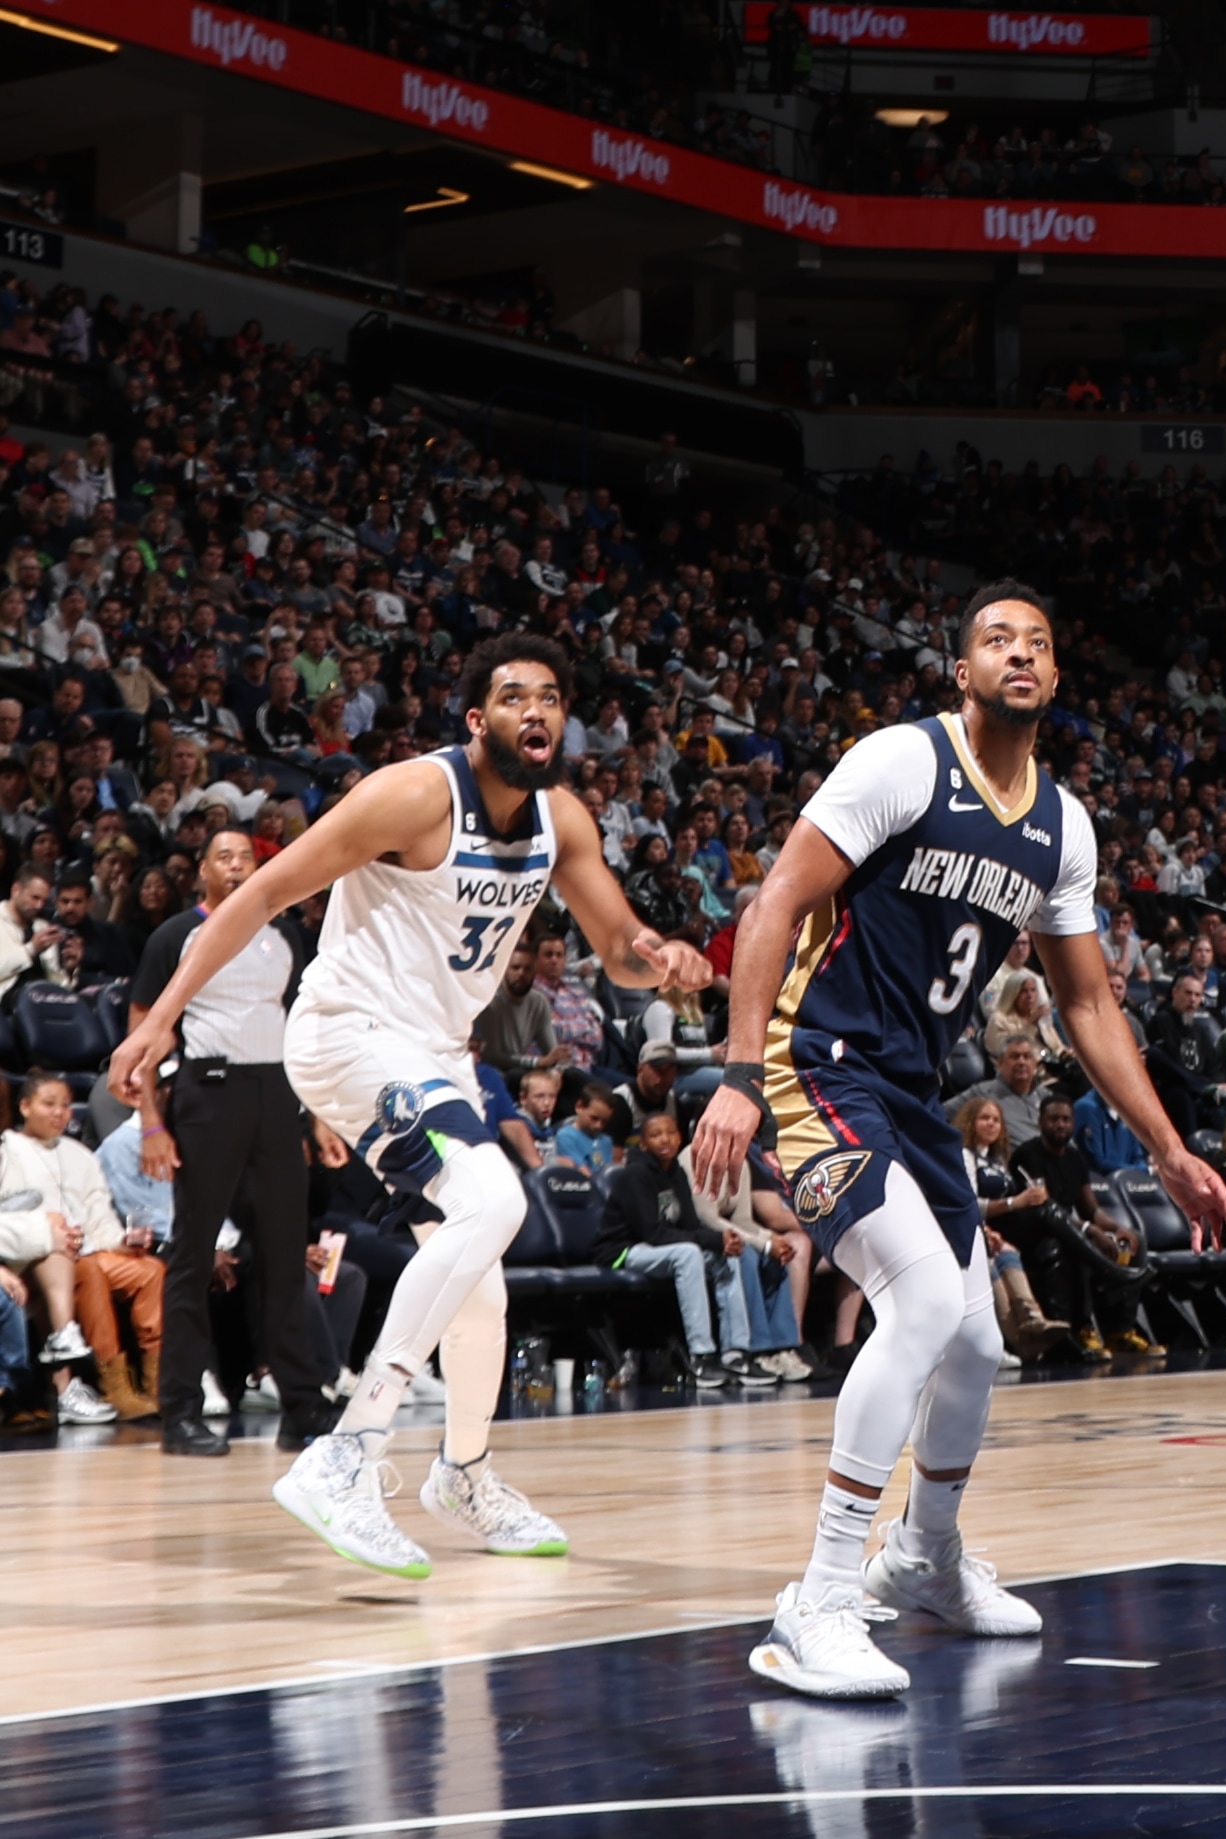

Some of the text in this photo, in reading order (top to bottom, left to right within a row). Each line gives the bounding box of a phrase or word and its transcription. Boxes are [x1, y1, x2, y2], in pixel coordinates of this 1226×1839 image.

[4, 227, 45, 260] 113
[1163, 428, 1204, 450] 116
[1022, 821, 1051, 847] ibotta
[456, 876, 544, 907] WOLVES
[900, 847, 1045, 932] NEW ORLEAN
[448, 916, 515, 973] 32
[928, 922, 982, 1014] 3
